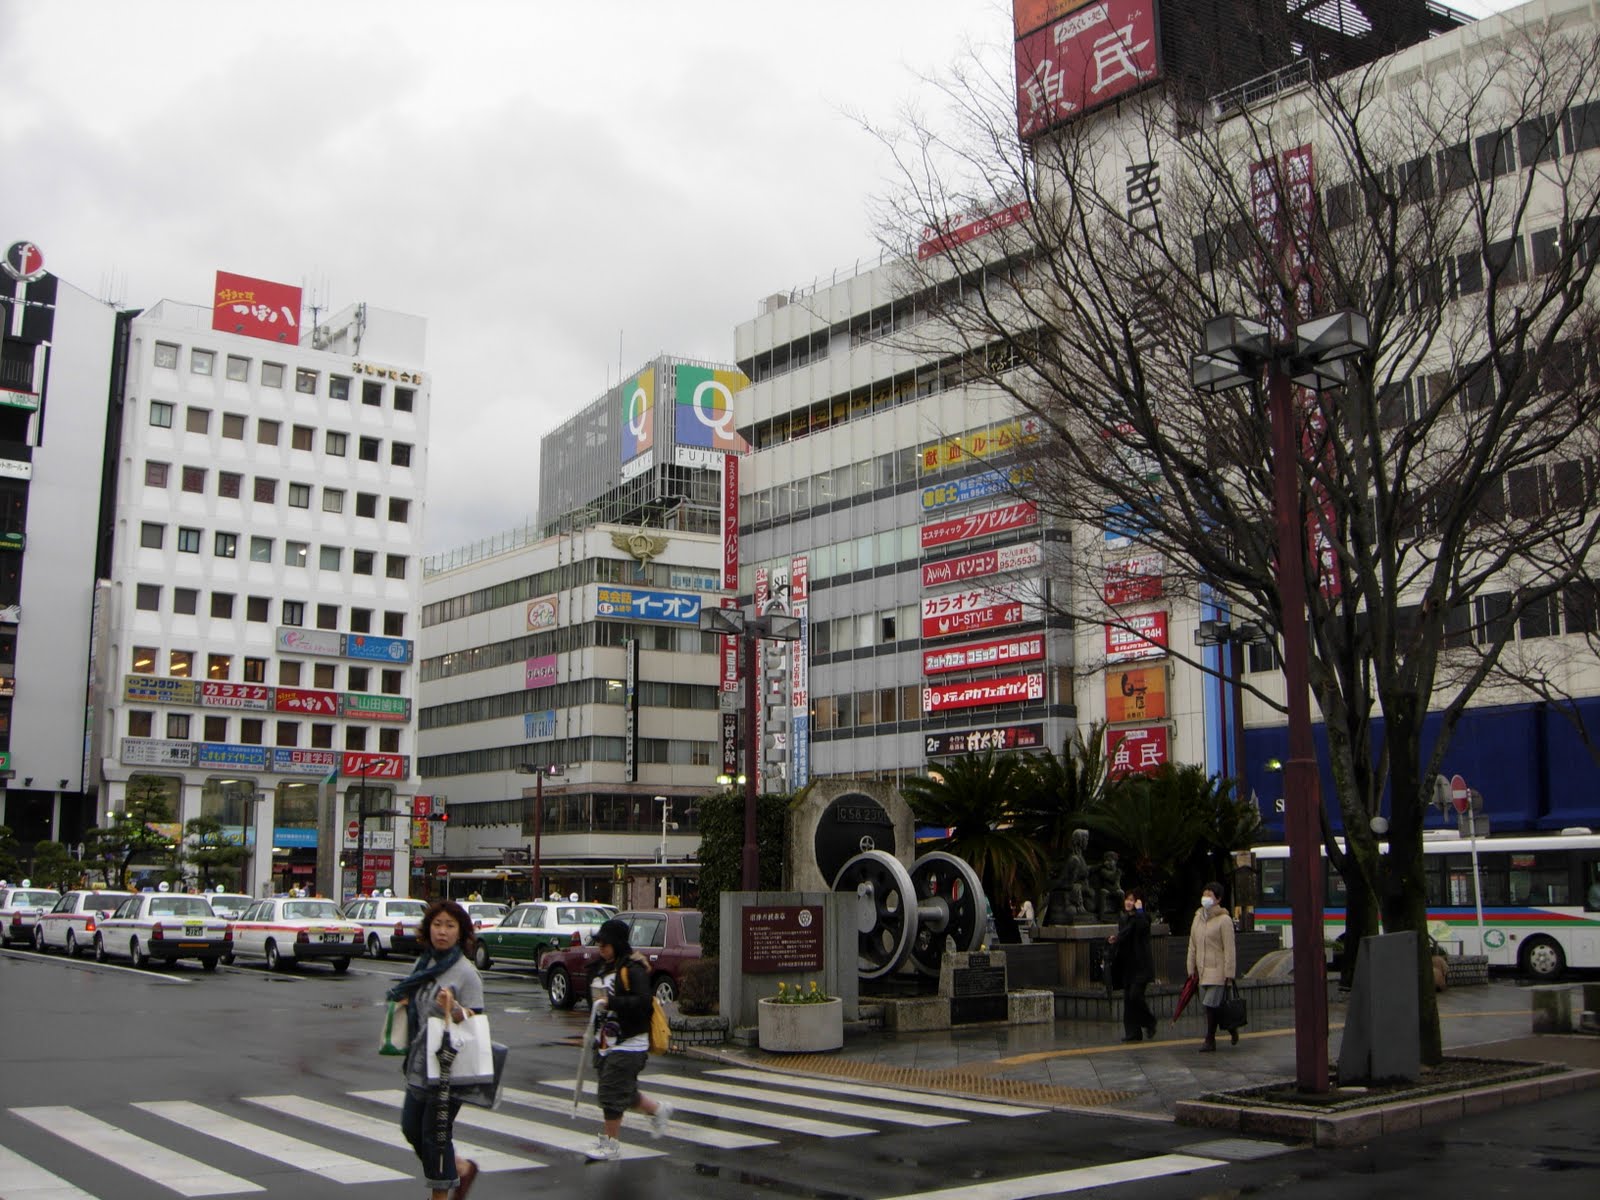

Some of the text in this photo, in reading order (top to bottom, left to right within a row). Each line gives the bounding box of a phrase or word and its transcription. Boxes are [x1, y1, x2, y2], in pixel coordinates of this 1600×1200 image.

[1021, 24, 1153, 133] 魚民
[233, 304, 295, 327] つぼ八
[629, 387, 647, 442] Q
[692, 379, 734, 440] Q
[678, 449, 722, 464] FUJIK
[925, 430, 1012, 467] 献血ルーム
[923, 524, 962, 540] エステティック
[956, 556, 995, 576] パソコン
[726, 574, 736, 584] 5F
[632, 595, 699, 619] イーオン
[925, 592, 982, 615] カラオケ
[952, 609, 993, 627] U-STYLE
[1004, 608, 1020, 622] 4F
[140, 678, 183, 690] コンタクト
[206, 683, 265, 699] カラオケ
[725, 682, 737, 691] 3F
[205, 696, 242, 707] APOLLO
[288, 696, 335, 711] つぼ八
[359, 697, 403, 711] 山田歯科
[926, 738, 939, 752] 2F
[292, 751, 334, 765] 日建学院
[1112, 743, 1164, 771] 魚民
